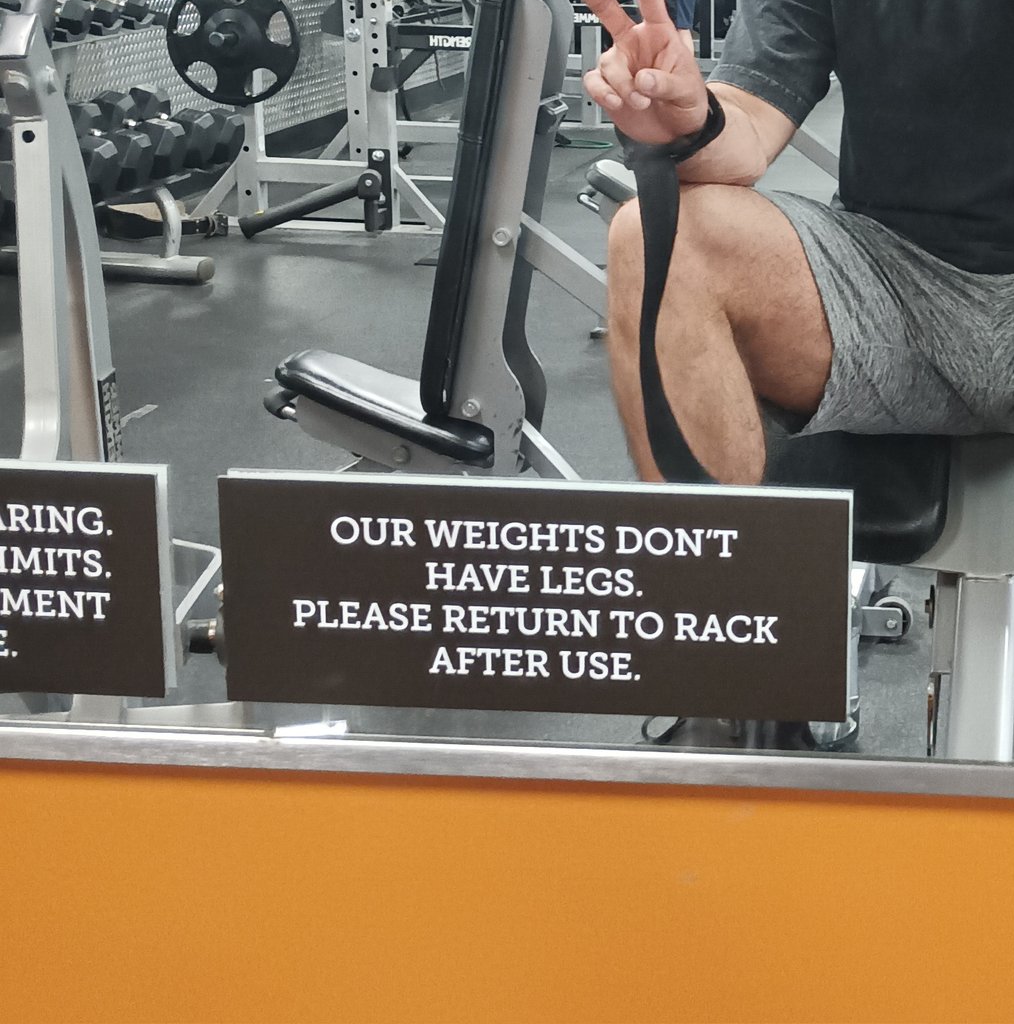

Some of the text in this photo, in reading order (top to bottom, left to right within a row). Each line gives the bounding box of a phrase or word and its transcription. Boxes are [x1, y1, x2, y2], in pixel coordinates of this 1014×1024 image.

[330, 516, 738, 558] OUR WEIGHTS DON'T
[425, 562, 643, 597] HAVE LEGS.
[0, 587, 111, 620] MENT
[292, 599, 778, 644] PLEASE RETURN TO RACK
[428, 646, 641, 681] AFTER USE.
